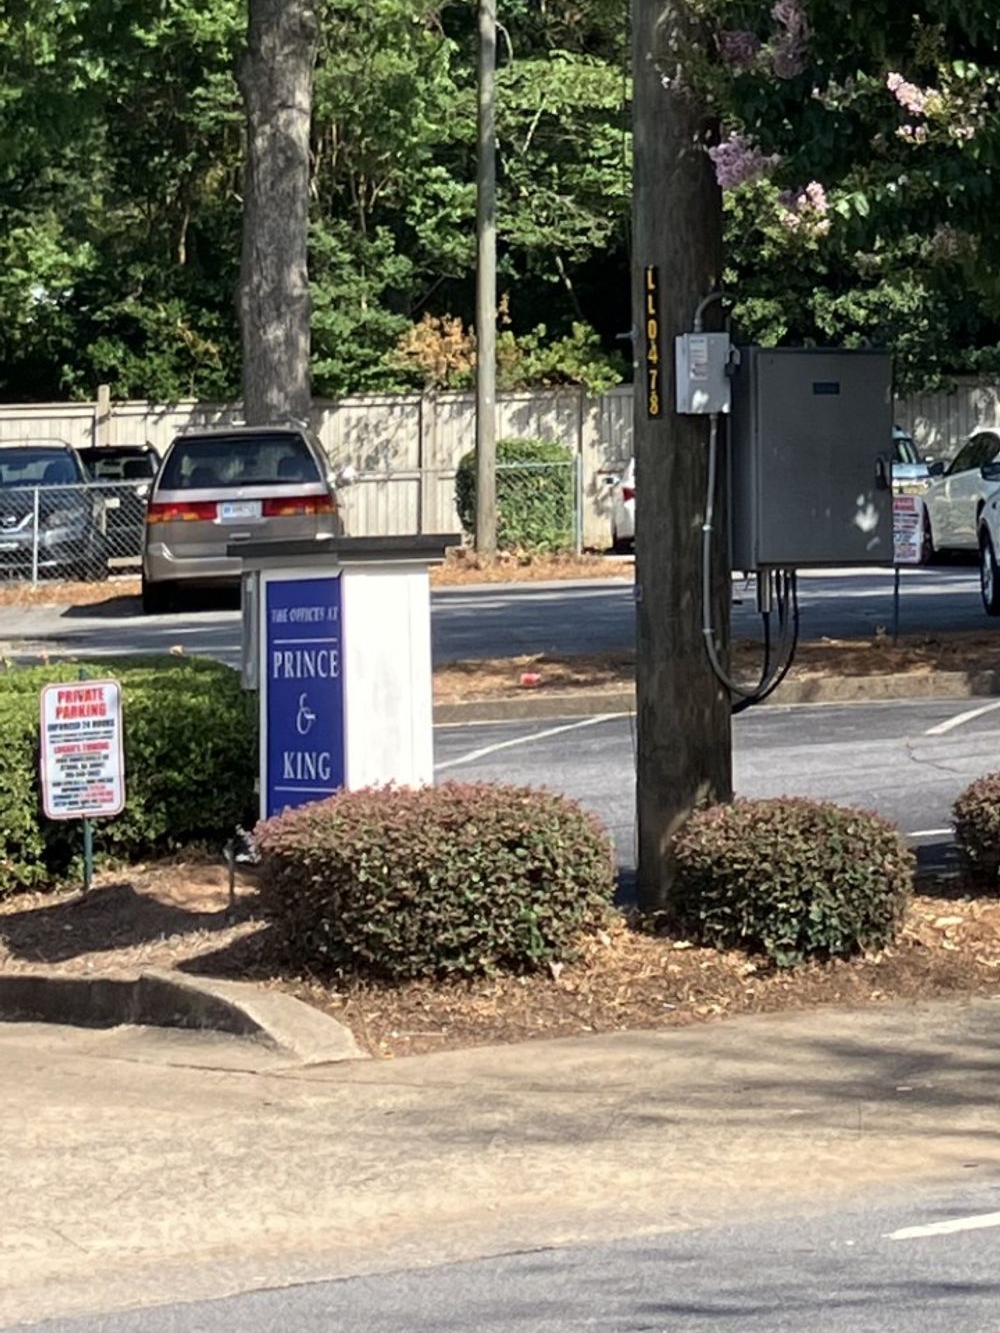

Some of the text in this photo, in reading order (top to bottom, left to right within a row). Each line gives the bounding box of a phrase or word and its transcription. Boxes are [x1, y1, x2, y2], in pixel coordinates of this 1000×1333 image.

[271, 606, 338, 623] THE OFFICES AT
[273, 650, 340, 678] PRINCE
[57, 688, 104, 703] PRIVATE
[55, 703, 107, 719] PARKING
[296, 692, 316, 735] &
[283, 751, 331, 780] KING
